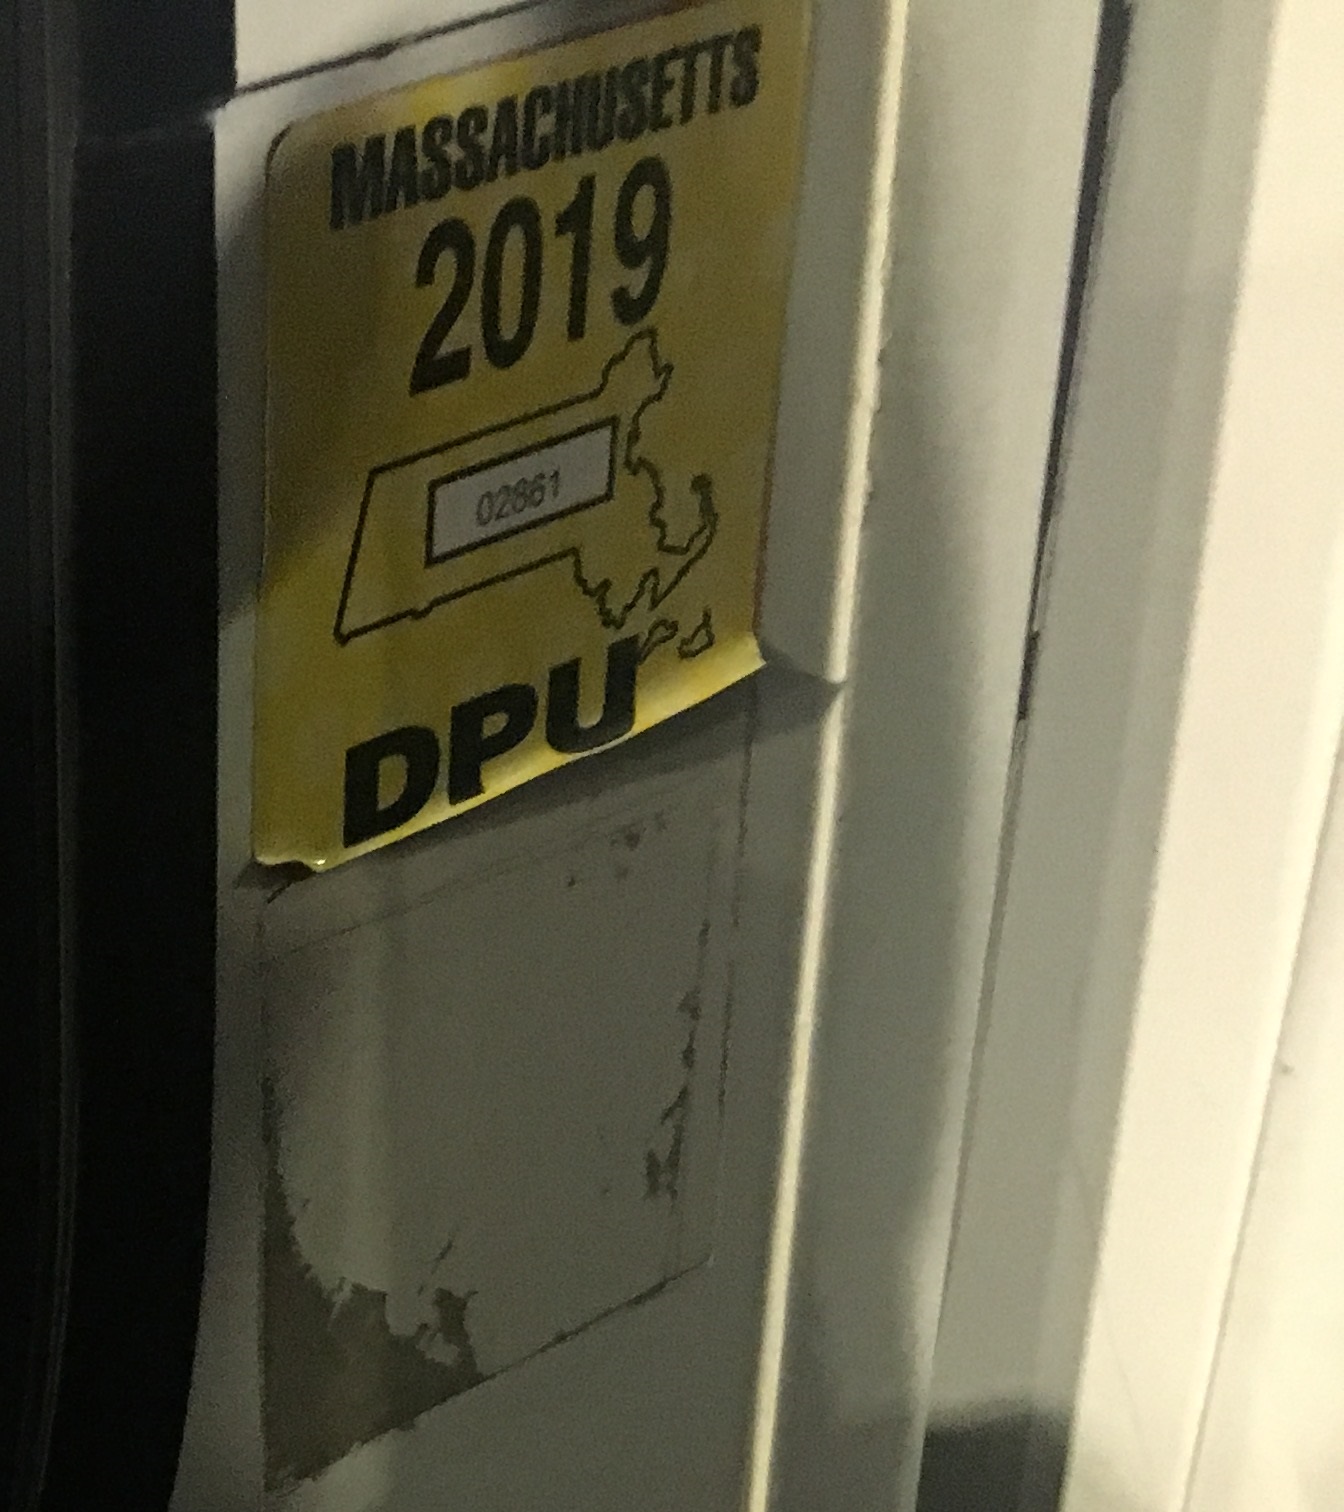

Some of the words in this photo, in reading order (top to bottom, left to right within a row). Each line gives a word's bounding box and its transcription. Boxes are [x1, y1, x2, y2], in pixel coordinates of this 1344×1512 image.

[330, 25, 761, 231] MASSACHUSETTS
[409, 156, 672, 397] 2019
[476, 469, 560, 527] 02861
[342, 634, 639, 848] DPU
